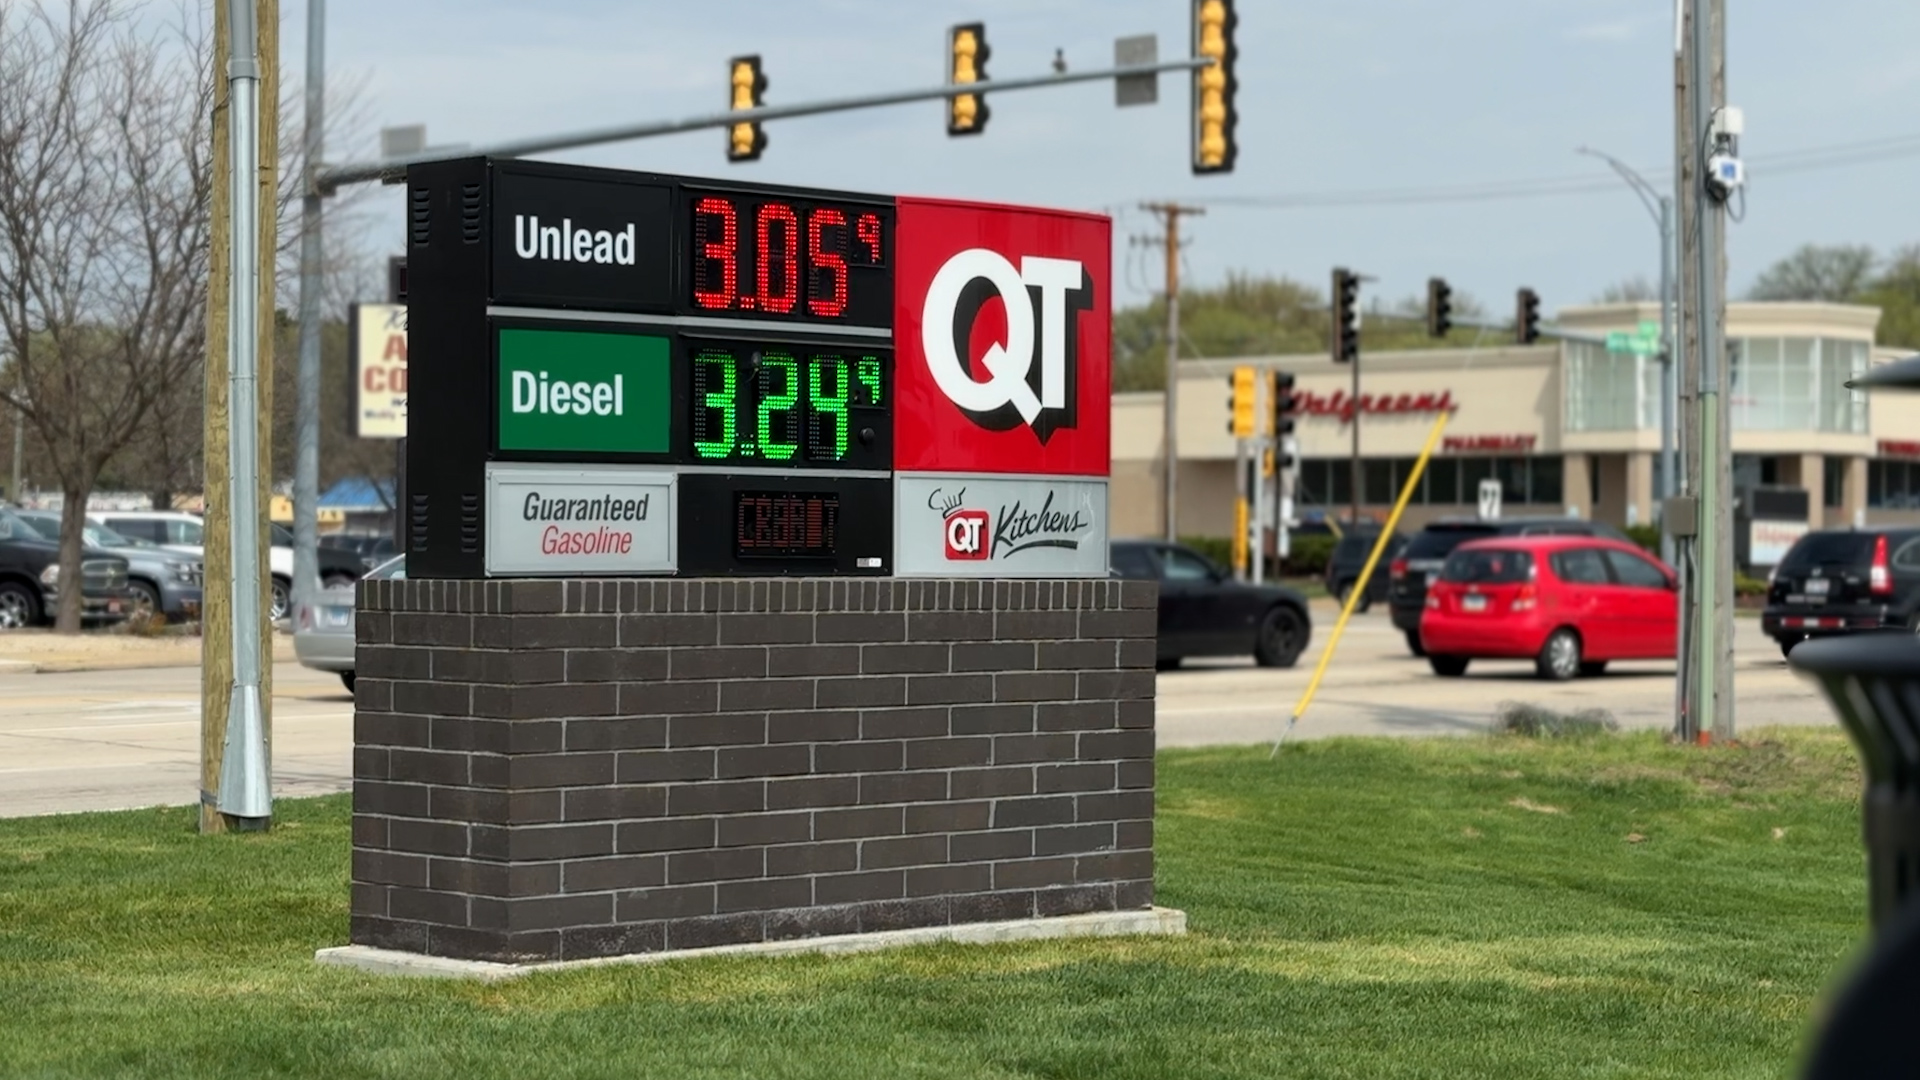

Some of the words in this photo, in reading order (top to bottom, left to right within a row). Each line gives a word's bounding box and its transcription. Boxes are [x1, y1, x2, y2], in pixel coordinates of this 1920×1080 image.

[515, 214, 636, 265] Unlead
[694, 198, 848, 317] 3.05
[921, 247, 1086, 428] QT
[511, 370, 624, 416] Diesel
[694, 348, 849, 461] 3.24
[523, 491, 650, 521] Guaranteed
[541, 525, 633, 555] Gasoline
[947, 516, 984, 554] QT
[990, 489, 1088, 560] Kitchens
